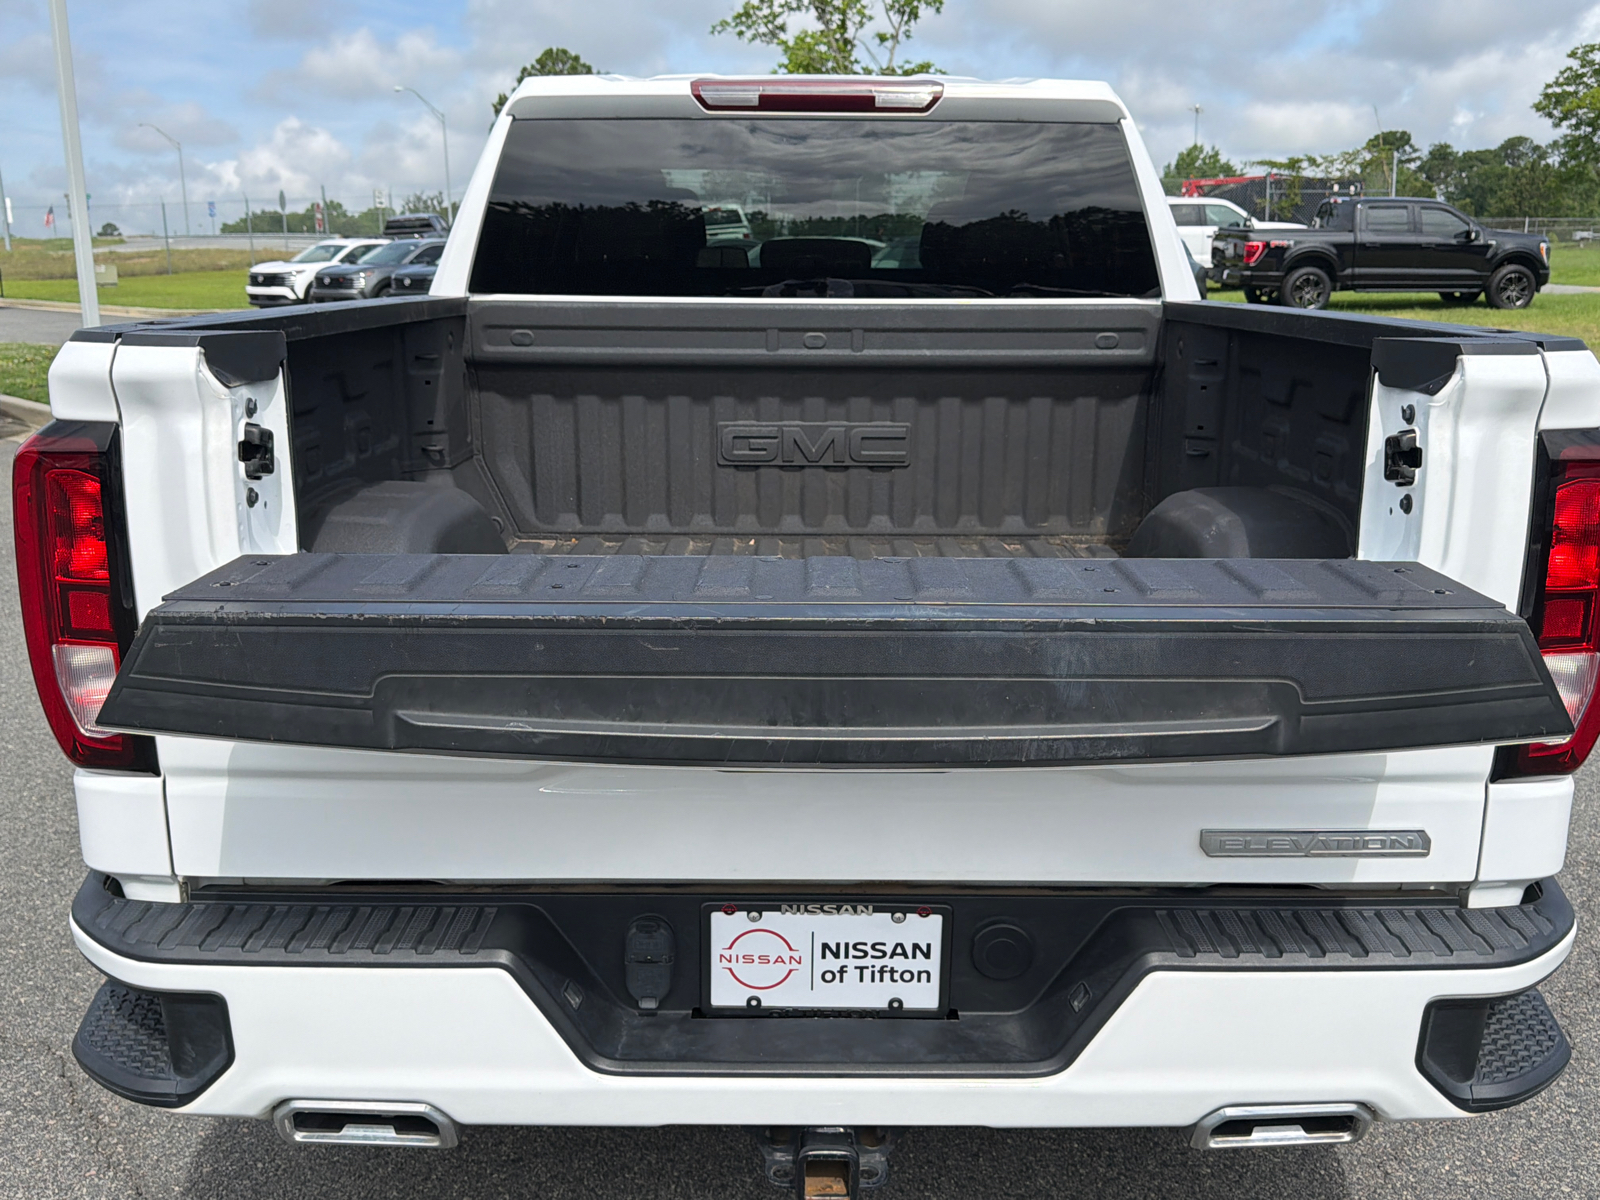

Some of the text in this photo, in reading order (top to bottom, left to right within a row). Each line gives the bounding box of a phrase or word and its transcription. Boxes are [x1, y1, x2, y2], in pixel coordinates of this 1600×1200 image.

[721, 426, 907, 464] GMC
[1218, 835, 1415, 851] ELEVATION
[780, 903, 874, 916] NISSAN
[719, 953, 802, 965] NISSAN
[820, 941, 932, 960] NISSAN
[820, 965, 932, 984] of Tifton
